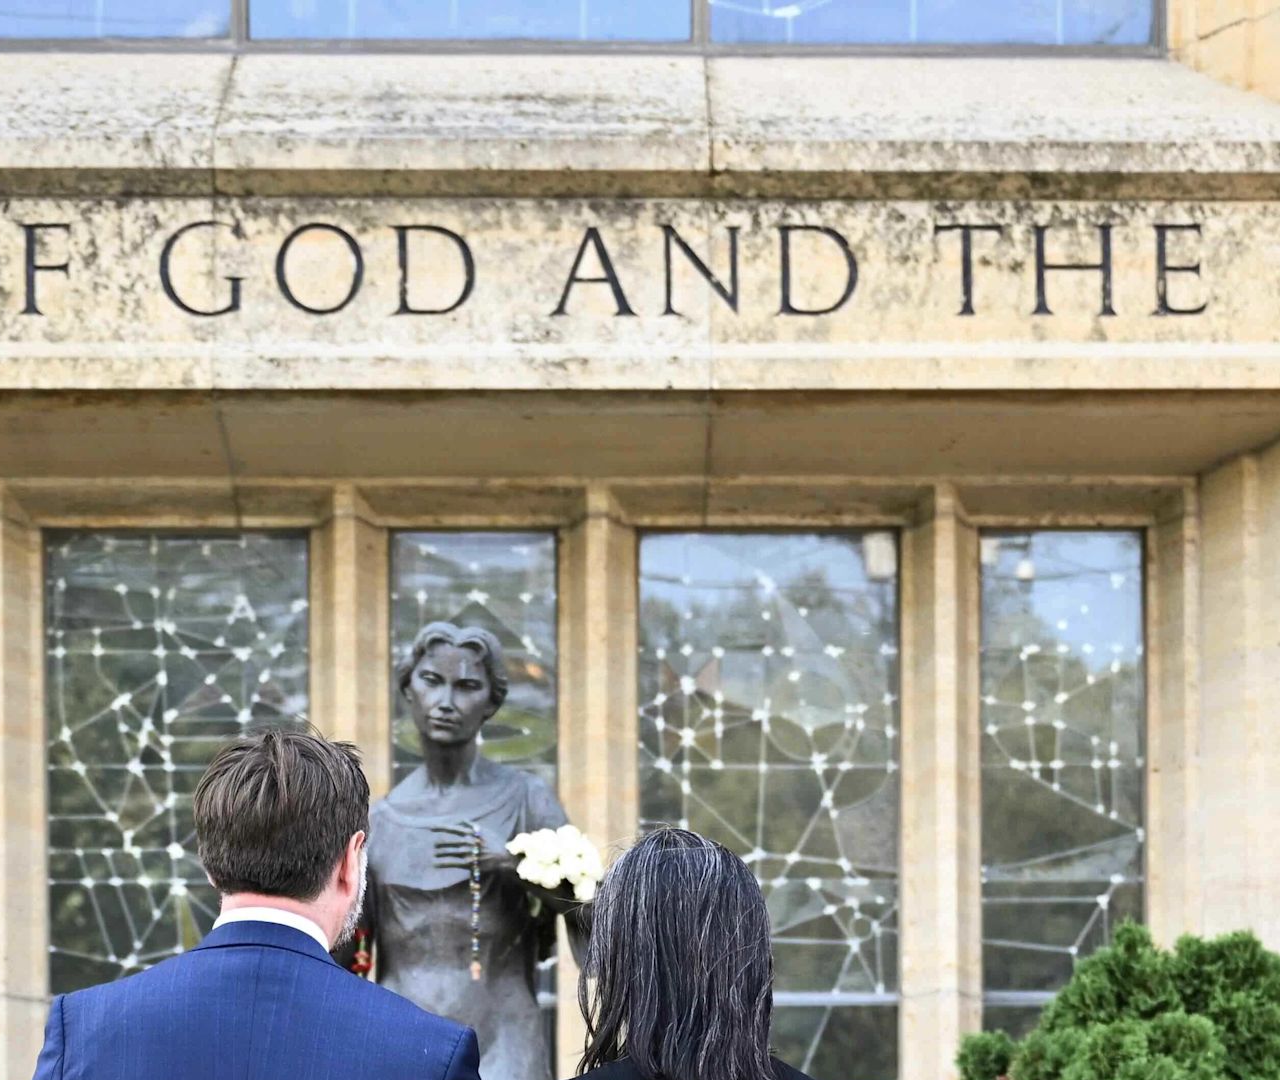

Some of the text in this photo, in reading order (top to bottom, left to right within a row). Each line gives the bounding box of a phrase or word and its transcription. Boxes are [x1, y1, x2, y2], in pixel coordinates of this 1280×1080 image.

[159, 221, 476, 316] GOD
[549, 224, 859, 317] AND
[933, 223, 1210, 317] THE
